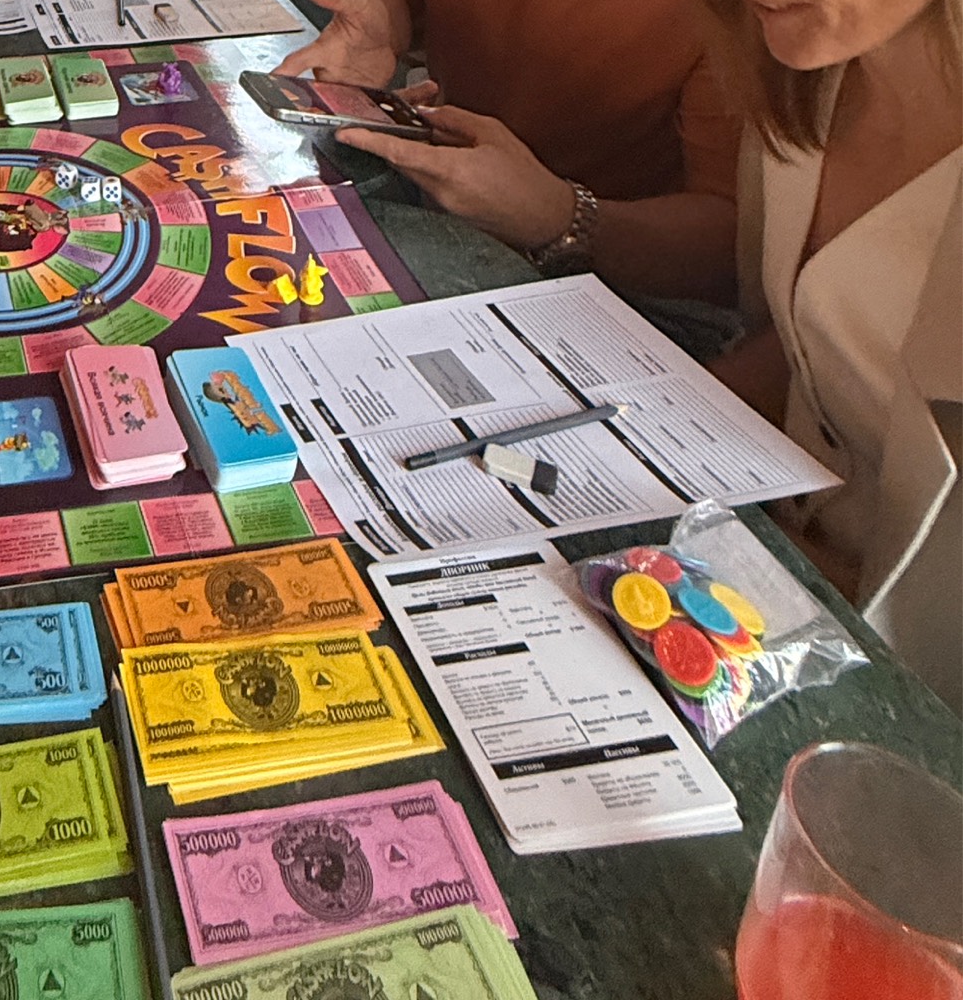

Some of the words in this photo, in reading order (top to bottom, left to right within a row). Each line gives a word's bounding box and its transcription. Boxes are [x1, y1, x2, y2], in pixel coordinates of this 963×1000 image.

[135, 656, 191, 674] 1000000
[36, 673, 66, 689] 500
[328, 703, 387, 723] 1000000
[48, 748, 77, 763] 1000
[51, 819, 92, 841] 1000
[181, 832, 237, 852] 500000
[414, 883, 474, 906] 500000
[74, 924, 110, 941] 5000
[416, 925, 460, 947] 100000
